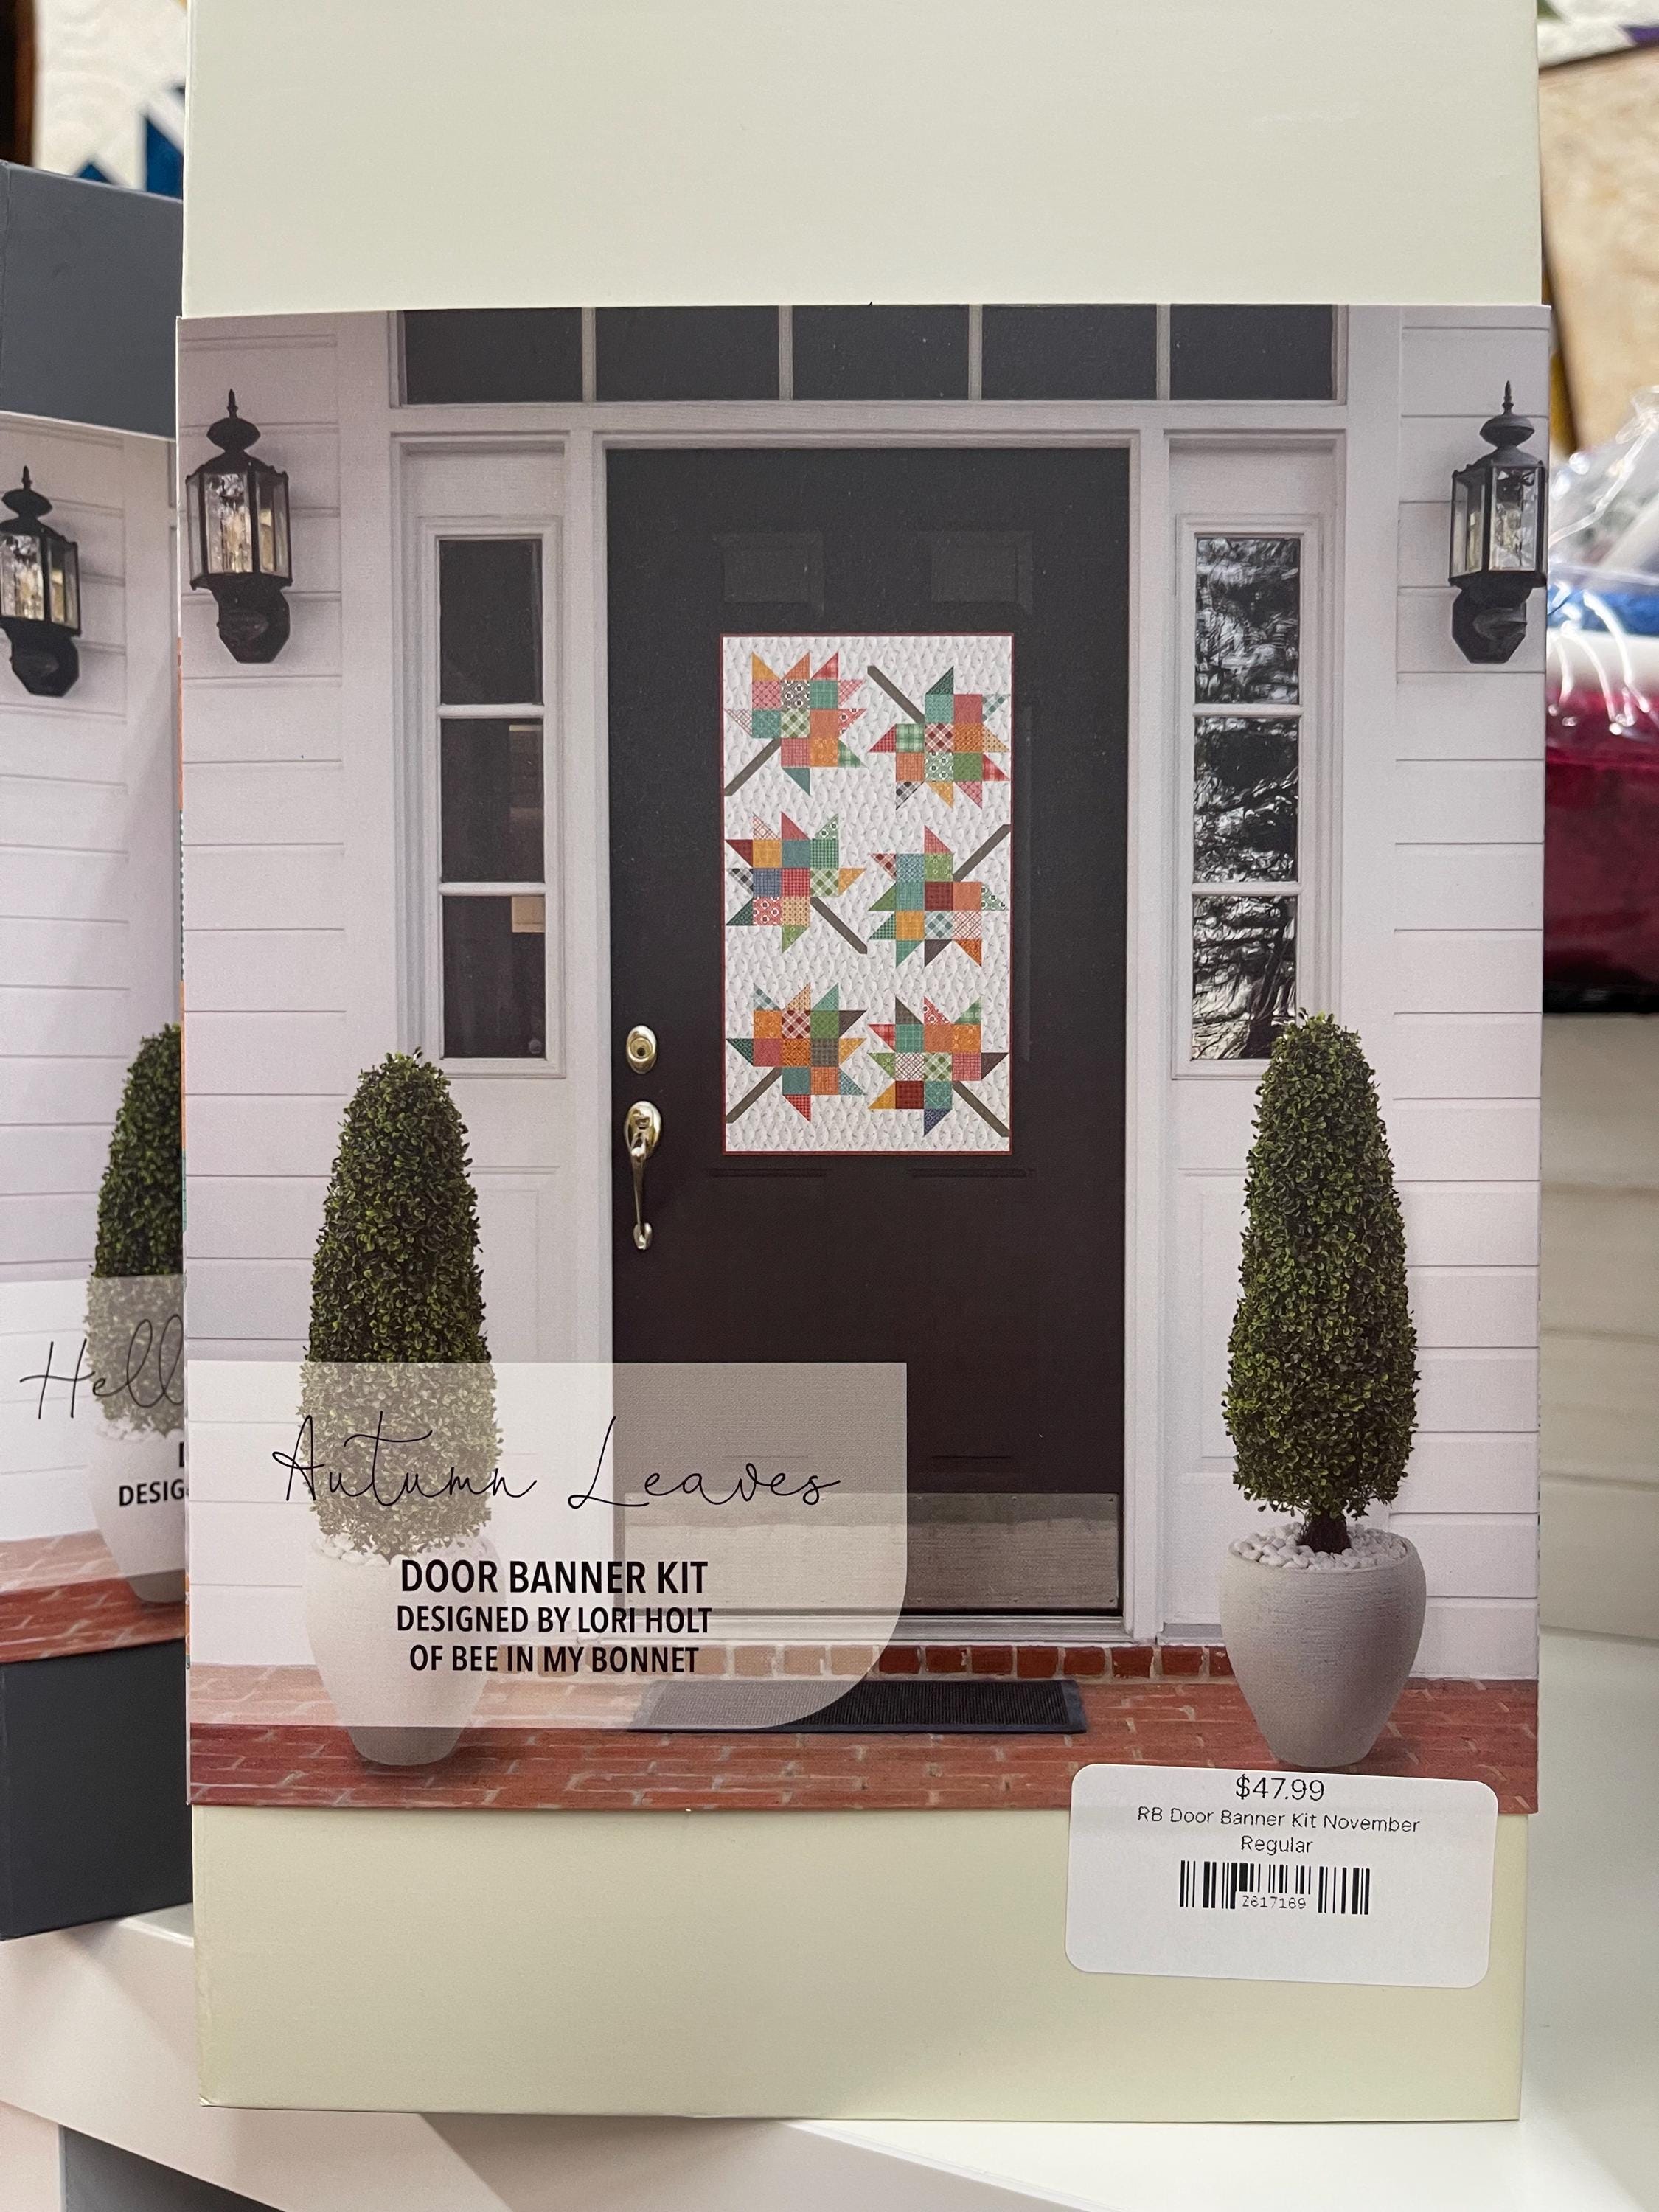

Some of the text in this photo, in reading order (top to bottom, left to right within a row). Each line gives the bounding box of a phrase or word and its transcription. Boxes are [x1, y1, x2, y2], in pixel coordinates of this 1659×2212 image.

[272, 1411, 841, 1509] Autumn Leaves
[402, 1559, 709, 1594] DOOR BANNER KIT
[397, 1605, 712, 1634] DESIGNED BY LORI HOLT
[410, 1644, 700, 1673] OF BEE IN MY BONNET
[1235, 1773, 1325, 1802] $47.99
[1138, 1806, 1421, 1833] RB Door Banner Kit November
[1241, 1835, 1314, 1857] Regular
[1242, 1895, 1307, 1910] 2617169
